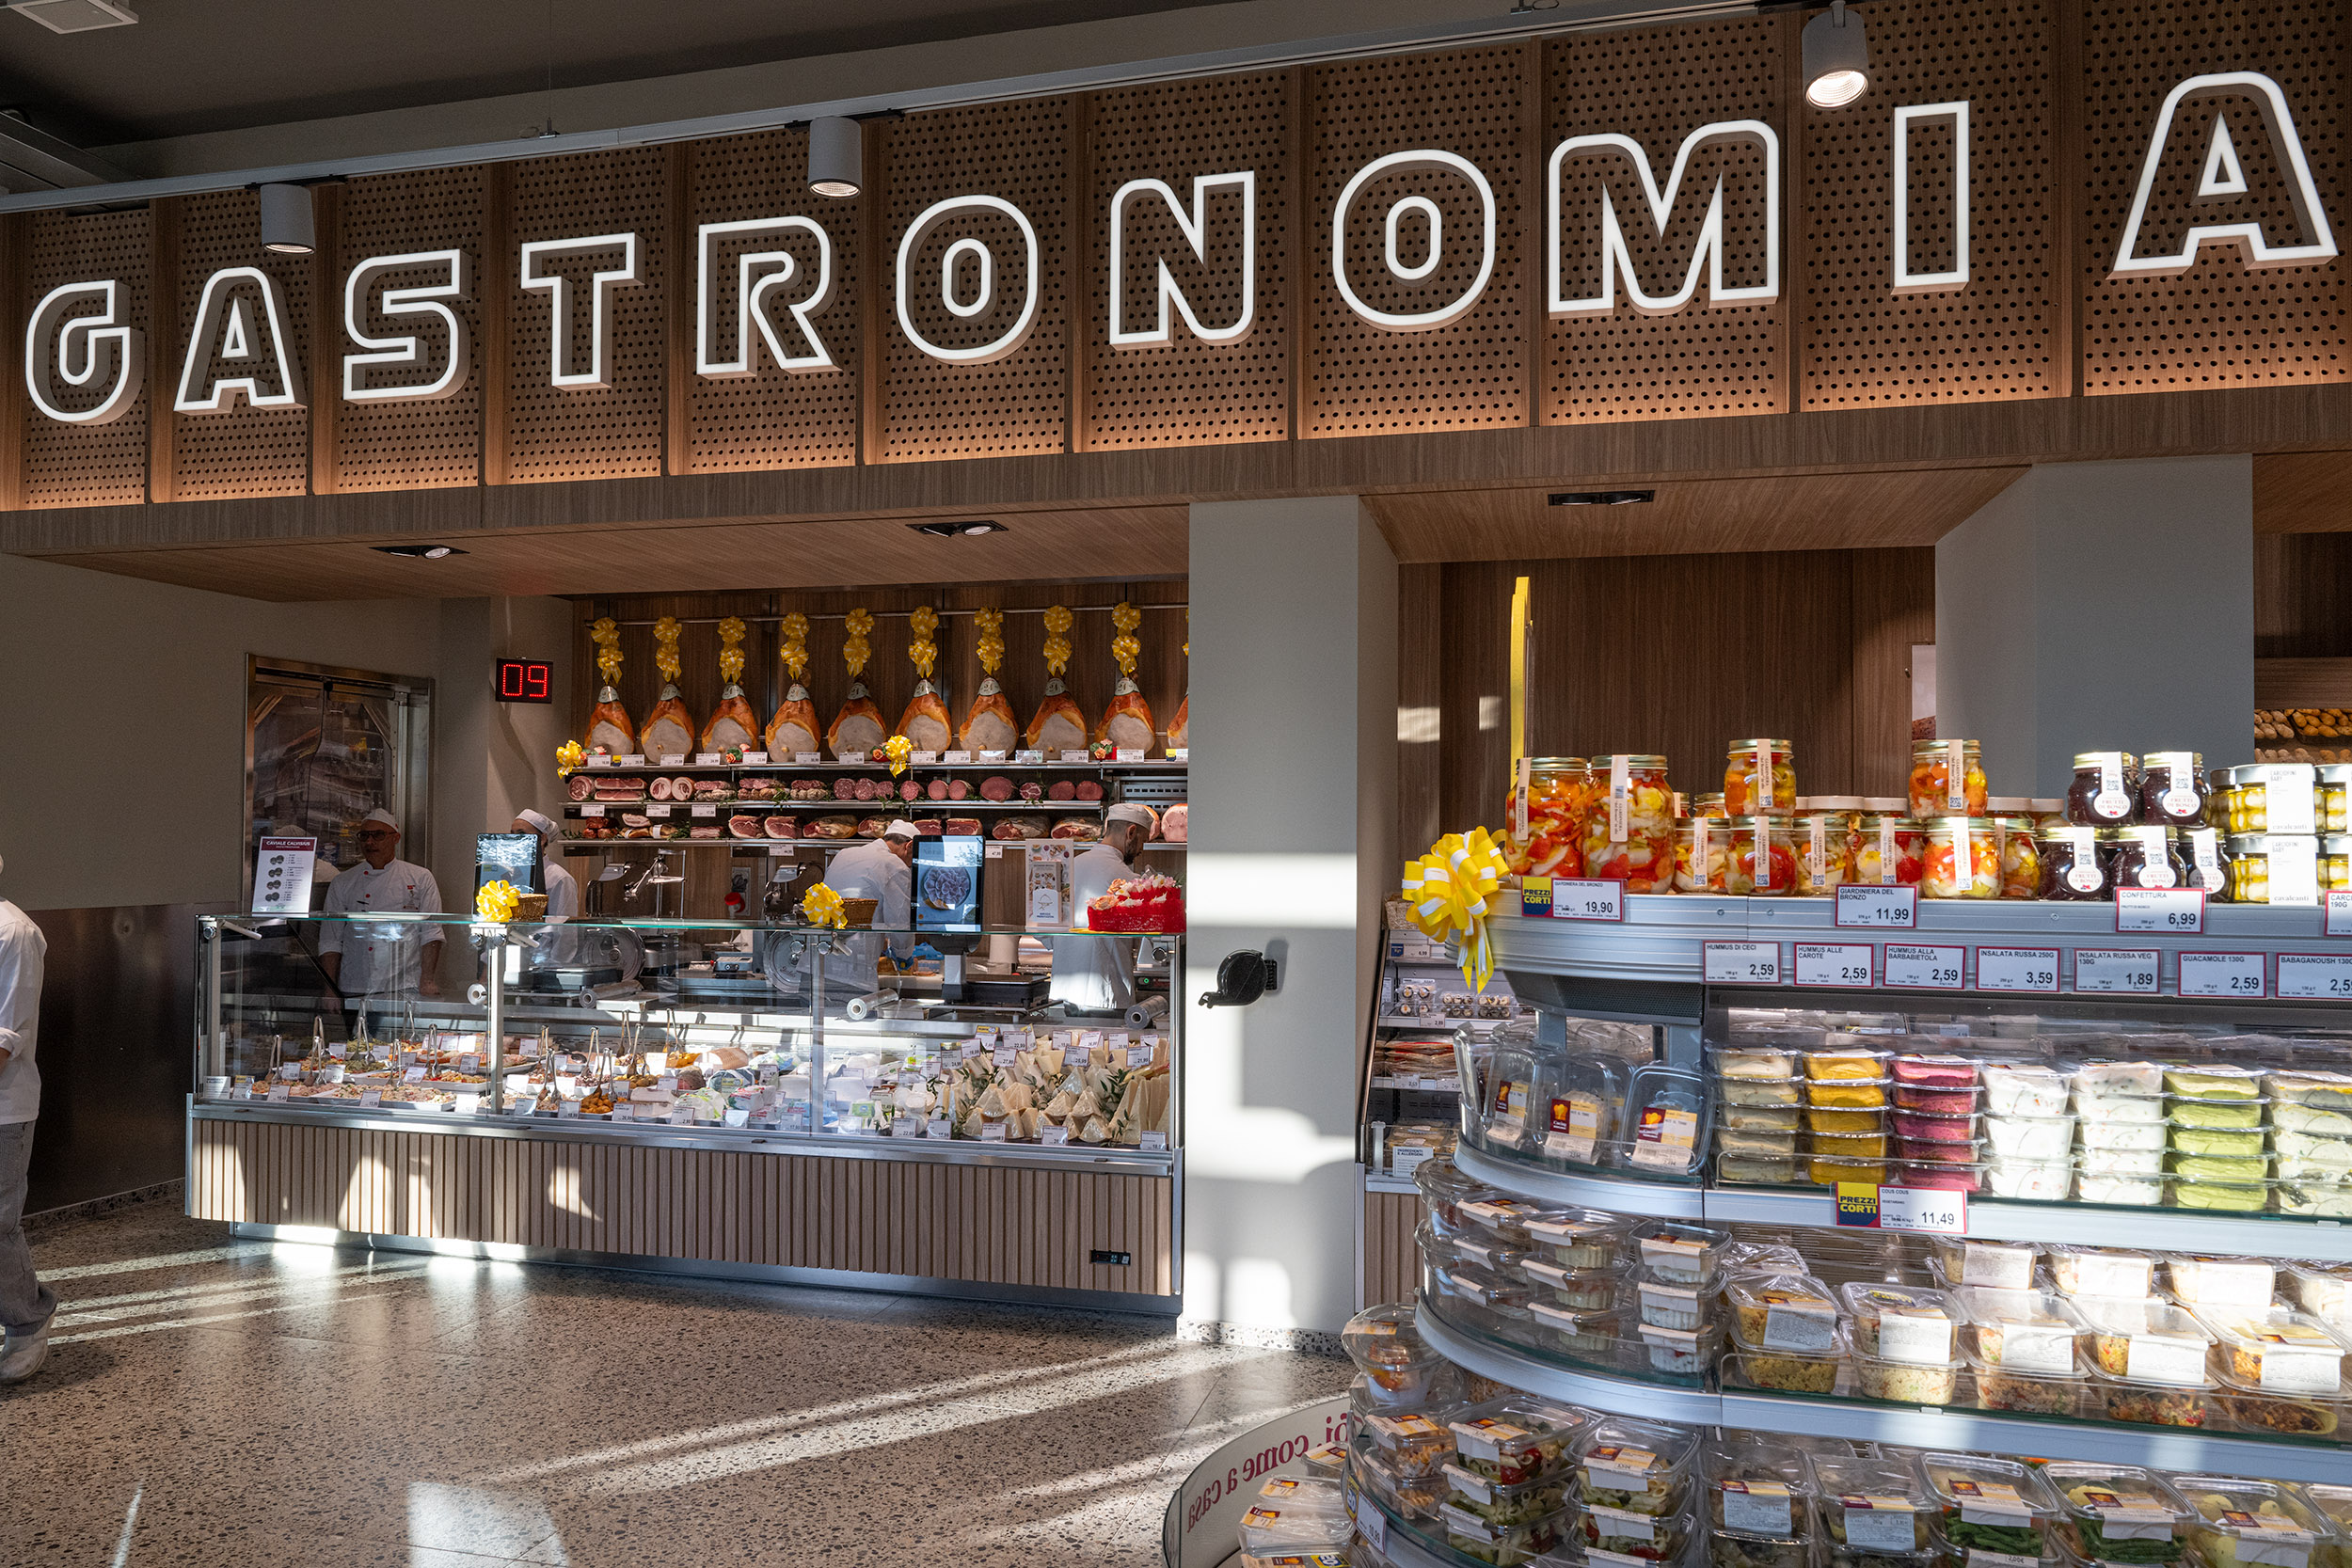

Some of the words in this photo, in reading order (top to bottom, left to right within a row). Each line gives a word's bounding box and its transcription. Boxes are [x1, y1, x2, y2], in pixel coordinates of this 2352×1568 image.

[25, 71, 2339, 425] GASTRONOMIA
[502, 664, 548, 697] 09
[1585, 902, 1613, 914] 19,90
[1876, 909, 1909, 922] 11,99
[2168, 912, 2196, 926] 6,99
[1750, 963, 1774, 978] 2,59
[1842, 967, 1867, 982] 2,59
[1932, 969, 1958, 983] 2,59
[2026, 972, 2053, 986] 3,59
[2126, 974, 2153, 986] 1,89
[2232, 977, 2259, 990] 2,59
[2329, 979, 2352, 992] 2,5
[1840, 1204, 1876, 1214] CORTI
[1922, 1212, 1955, 1227] 11,49
